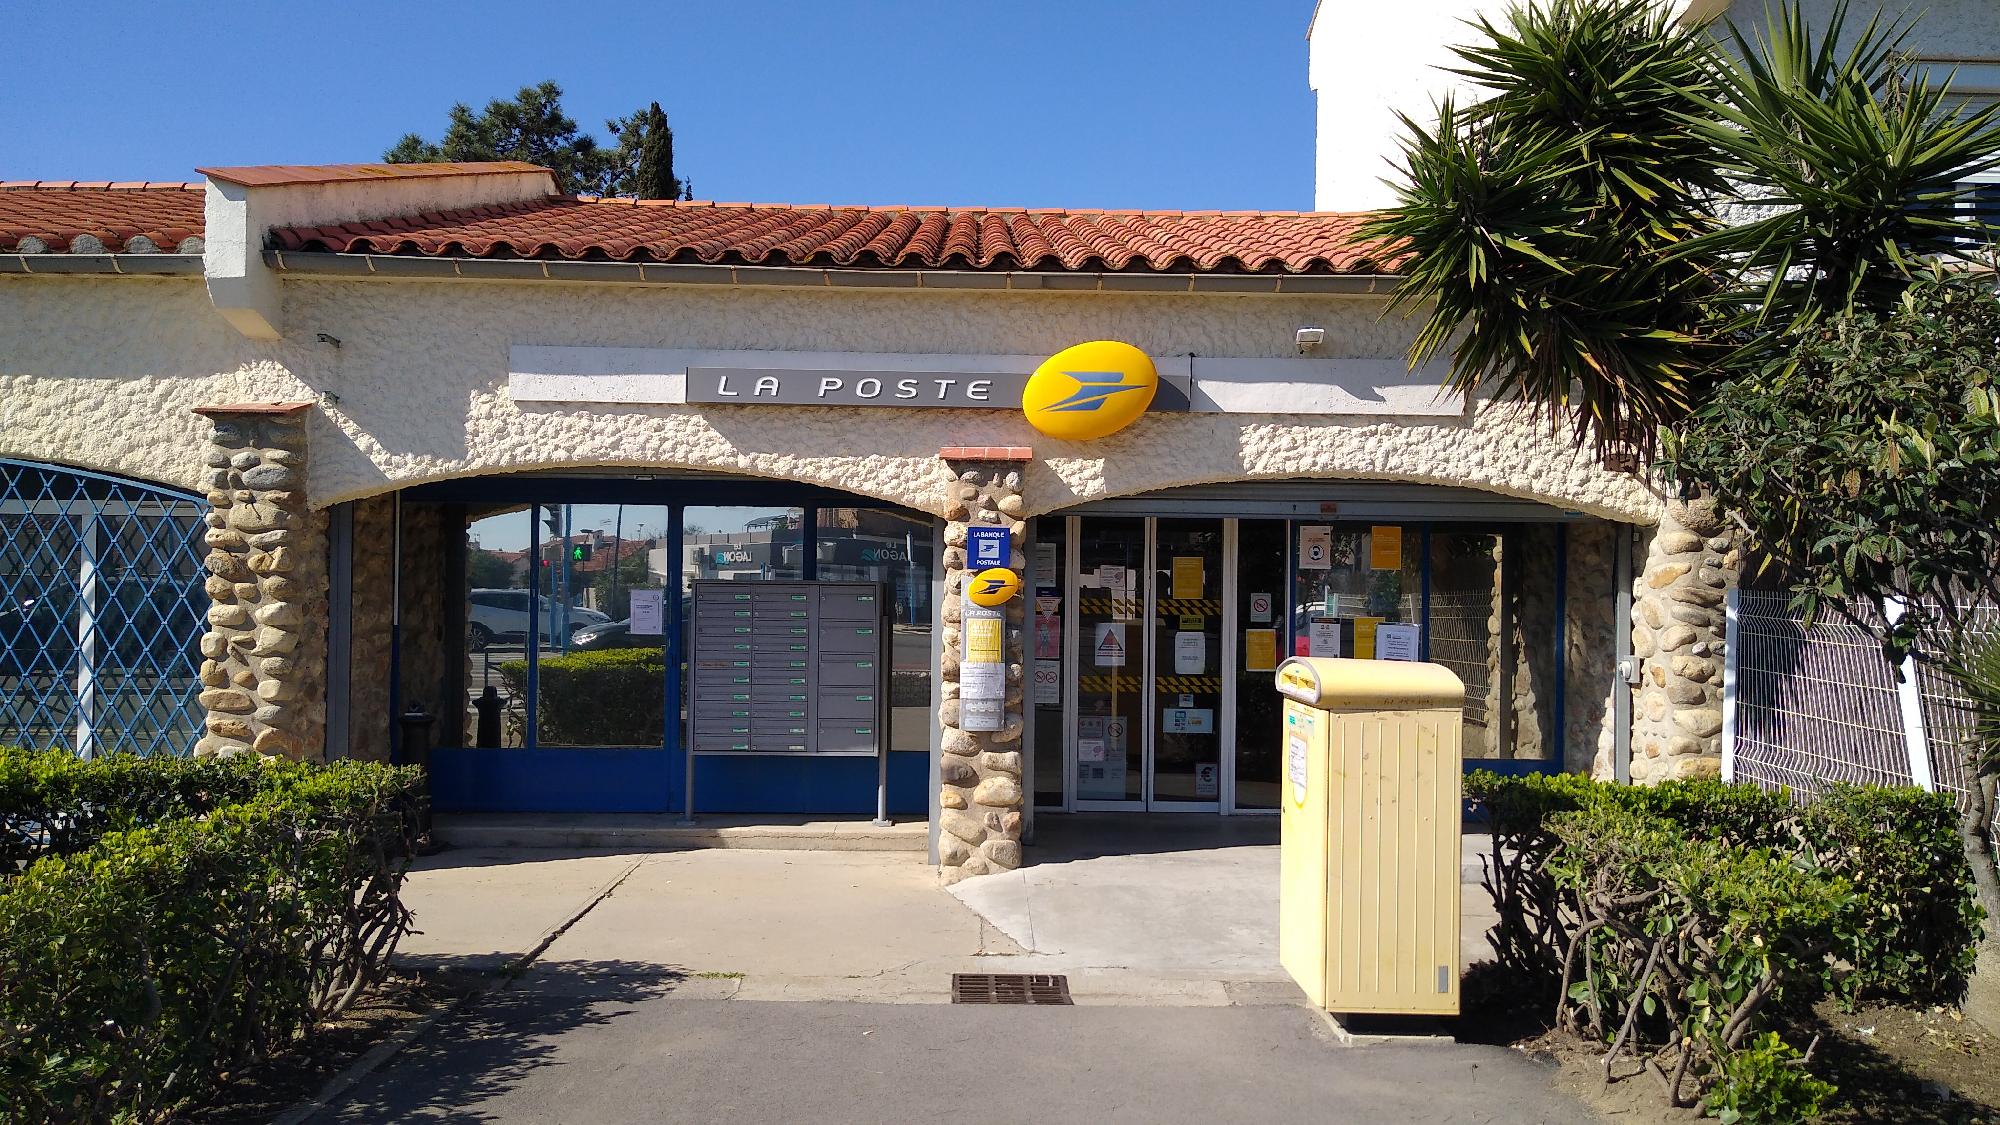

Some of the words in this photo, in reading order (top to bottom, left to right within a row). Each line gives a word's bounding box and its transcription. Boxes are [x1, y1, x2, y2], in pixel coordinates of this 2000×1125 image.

[717, 375, 781, 397] LA
[817, 377, 993, 401] POSTE
[980, 531, 1005, 539] BANQUE
